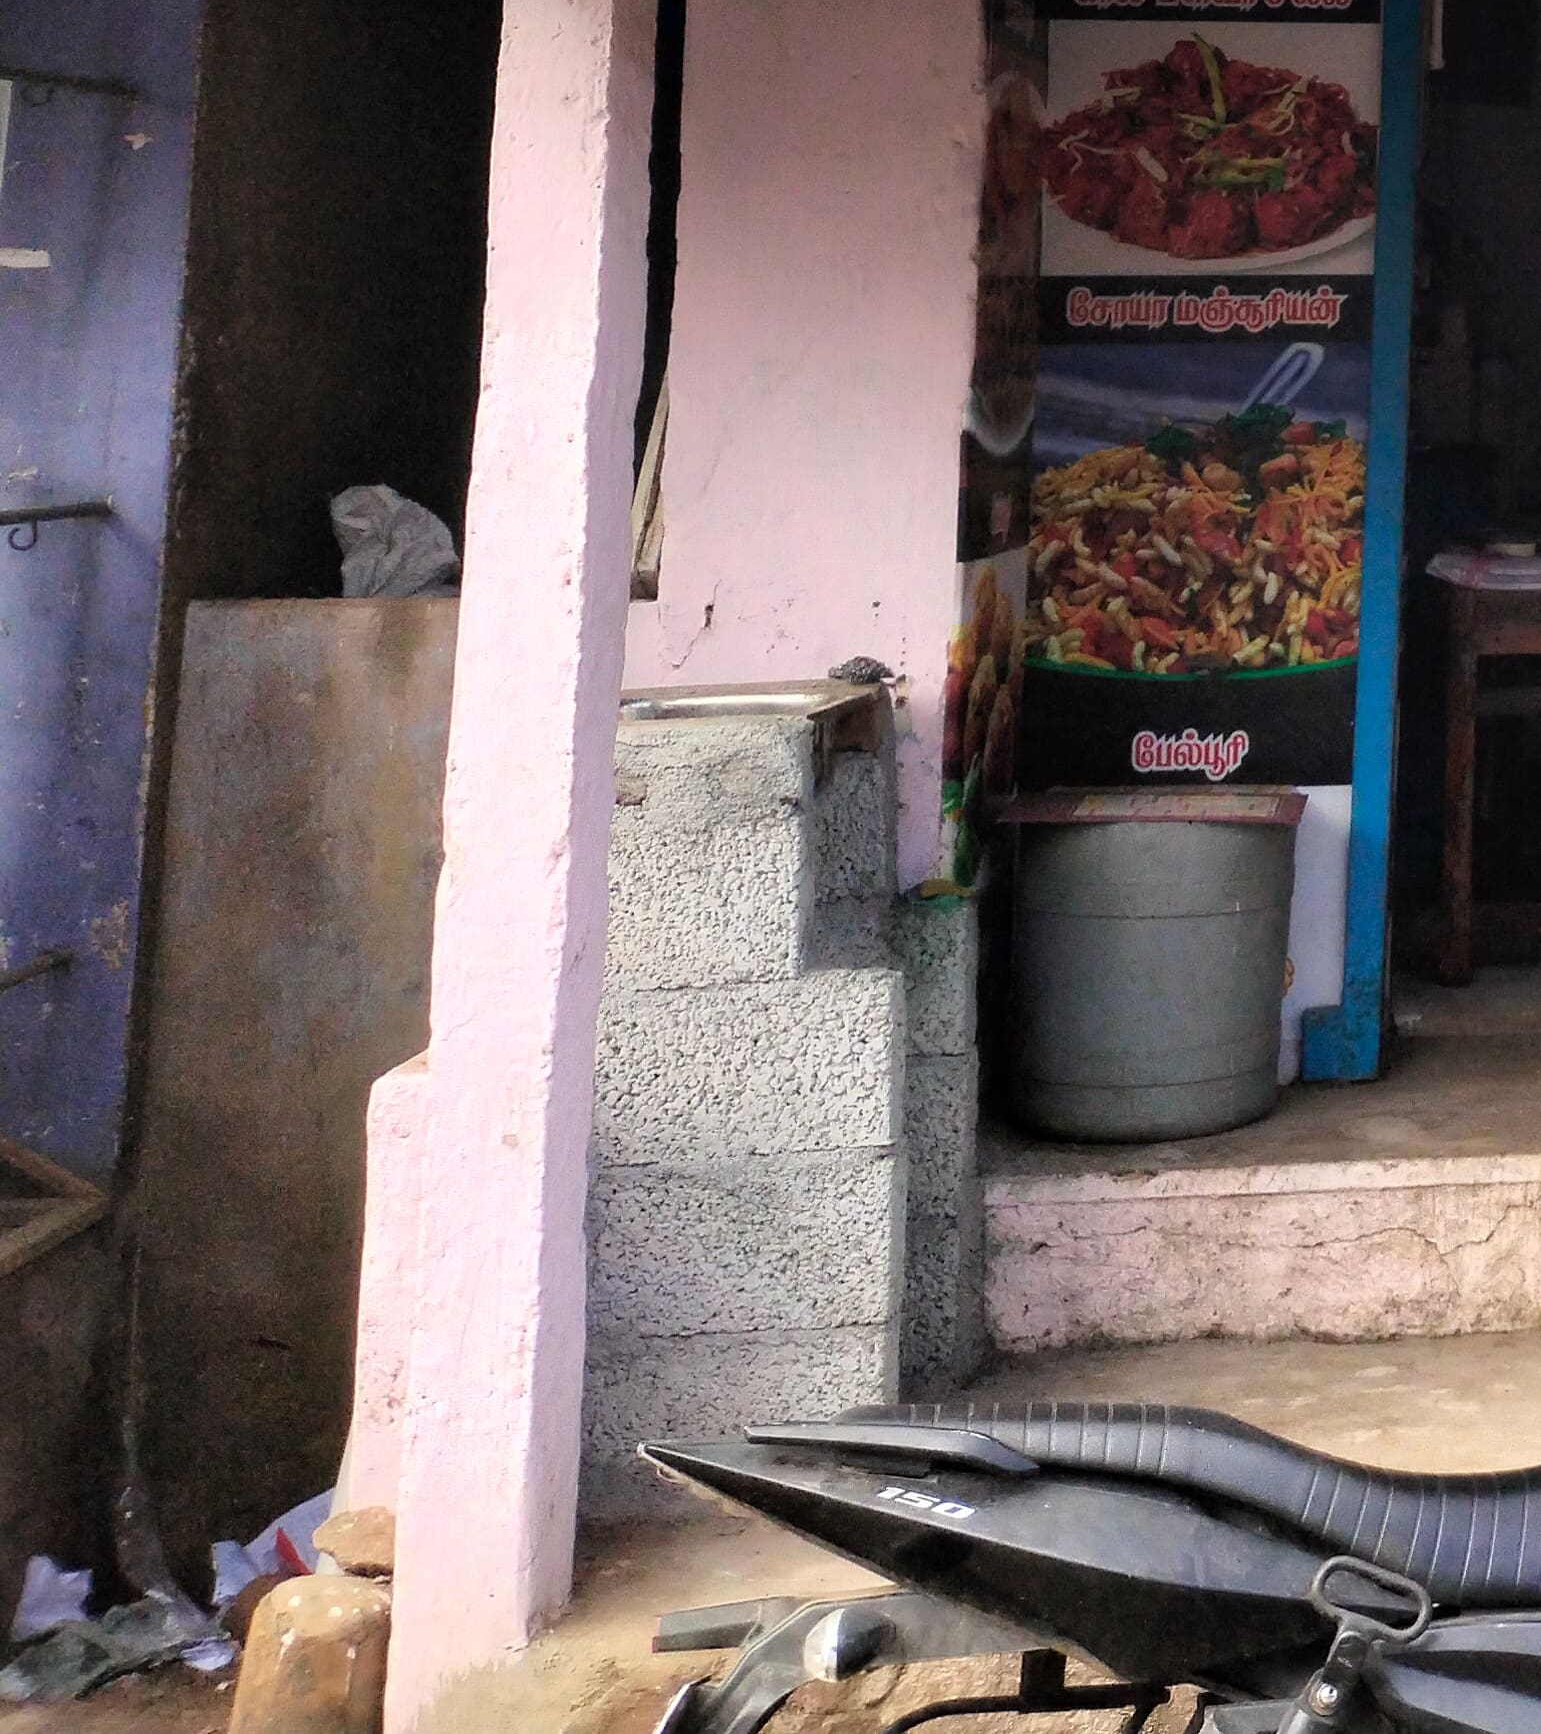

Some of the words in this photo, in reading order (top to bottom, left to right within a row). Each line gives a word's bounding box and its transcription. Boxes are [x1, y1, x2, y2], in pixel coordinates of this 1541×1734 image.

[1067, 286, 1171, 330] சோயா
[1131, 727, 1249, 781] பேல்பூரி
[875, 1485, 977, 1521] 150
